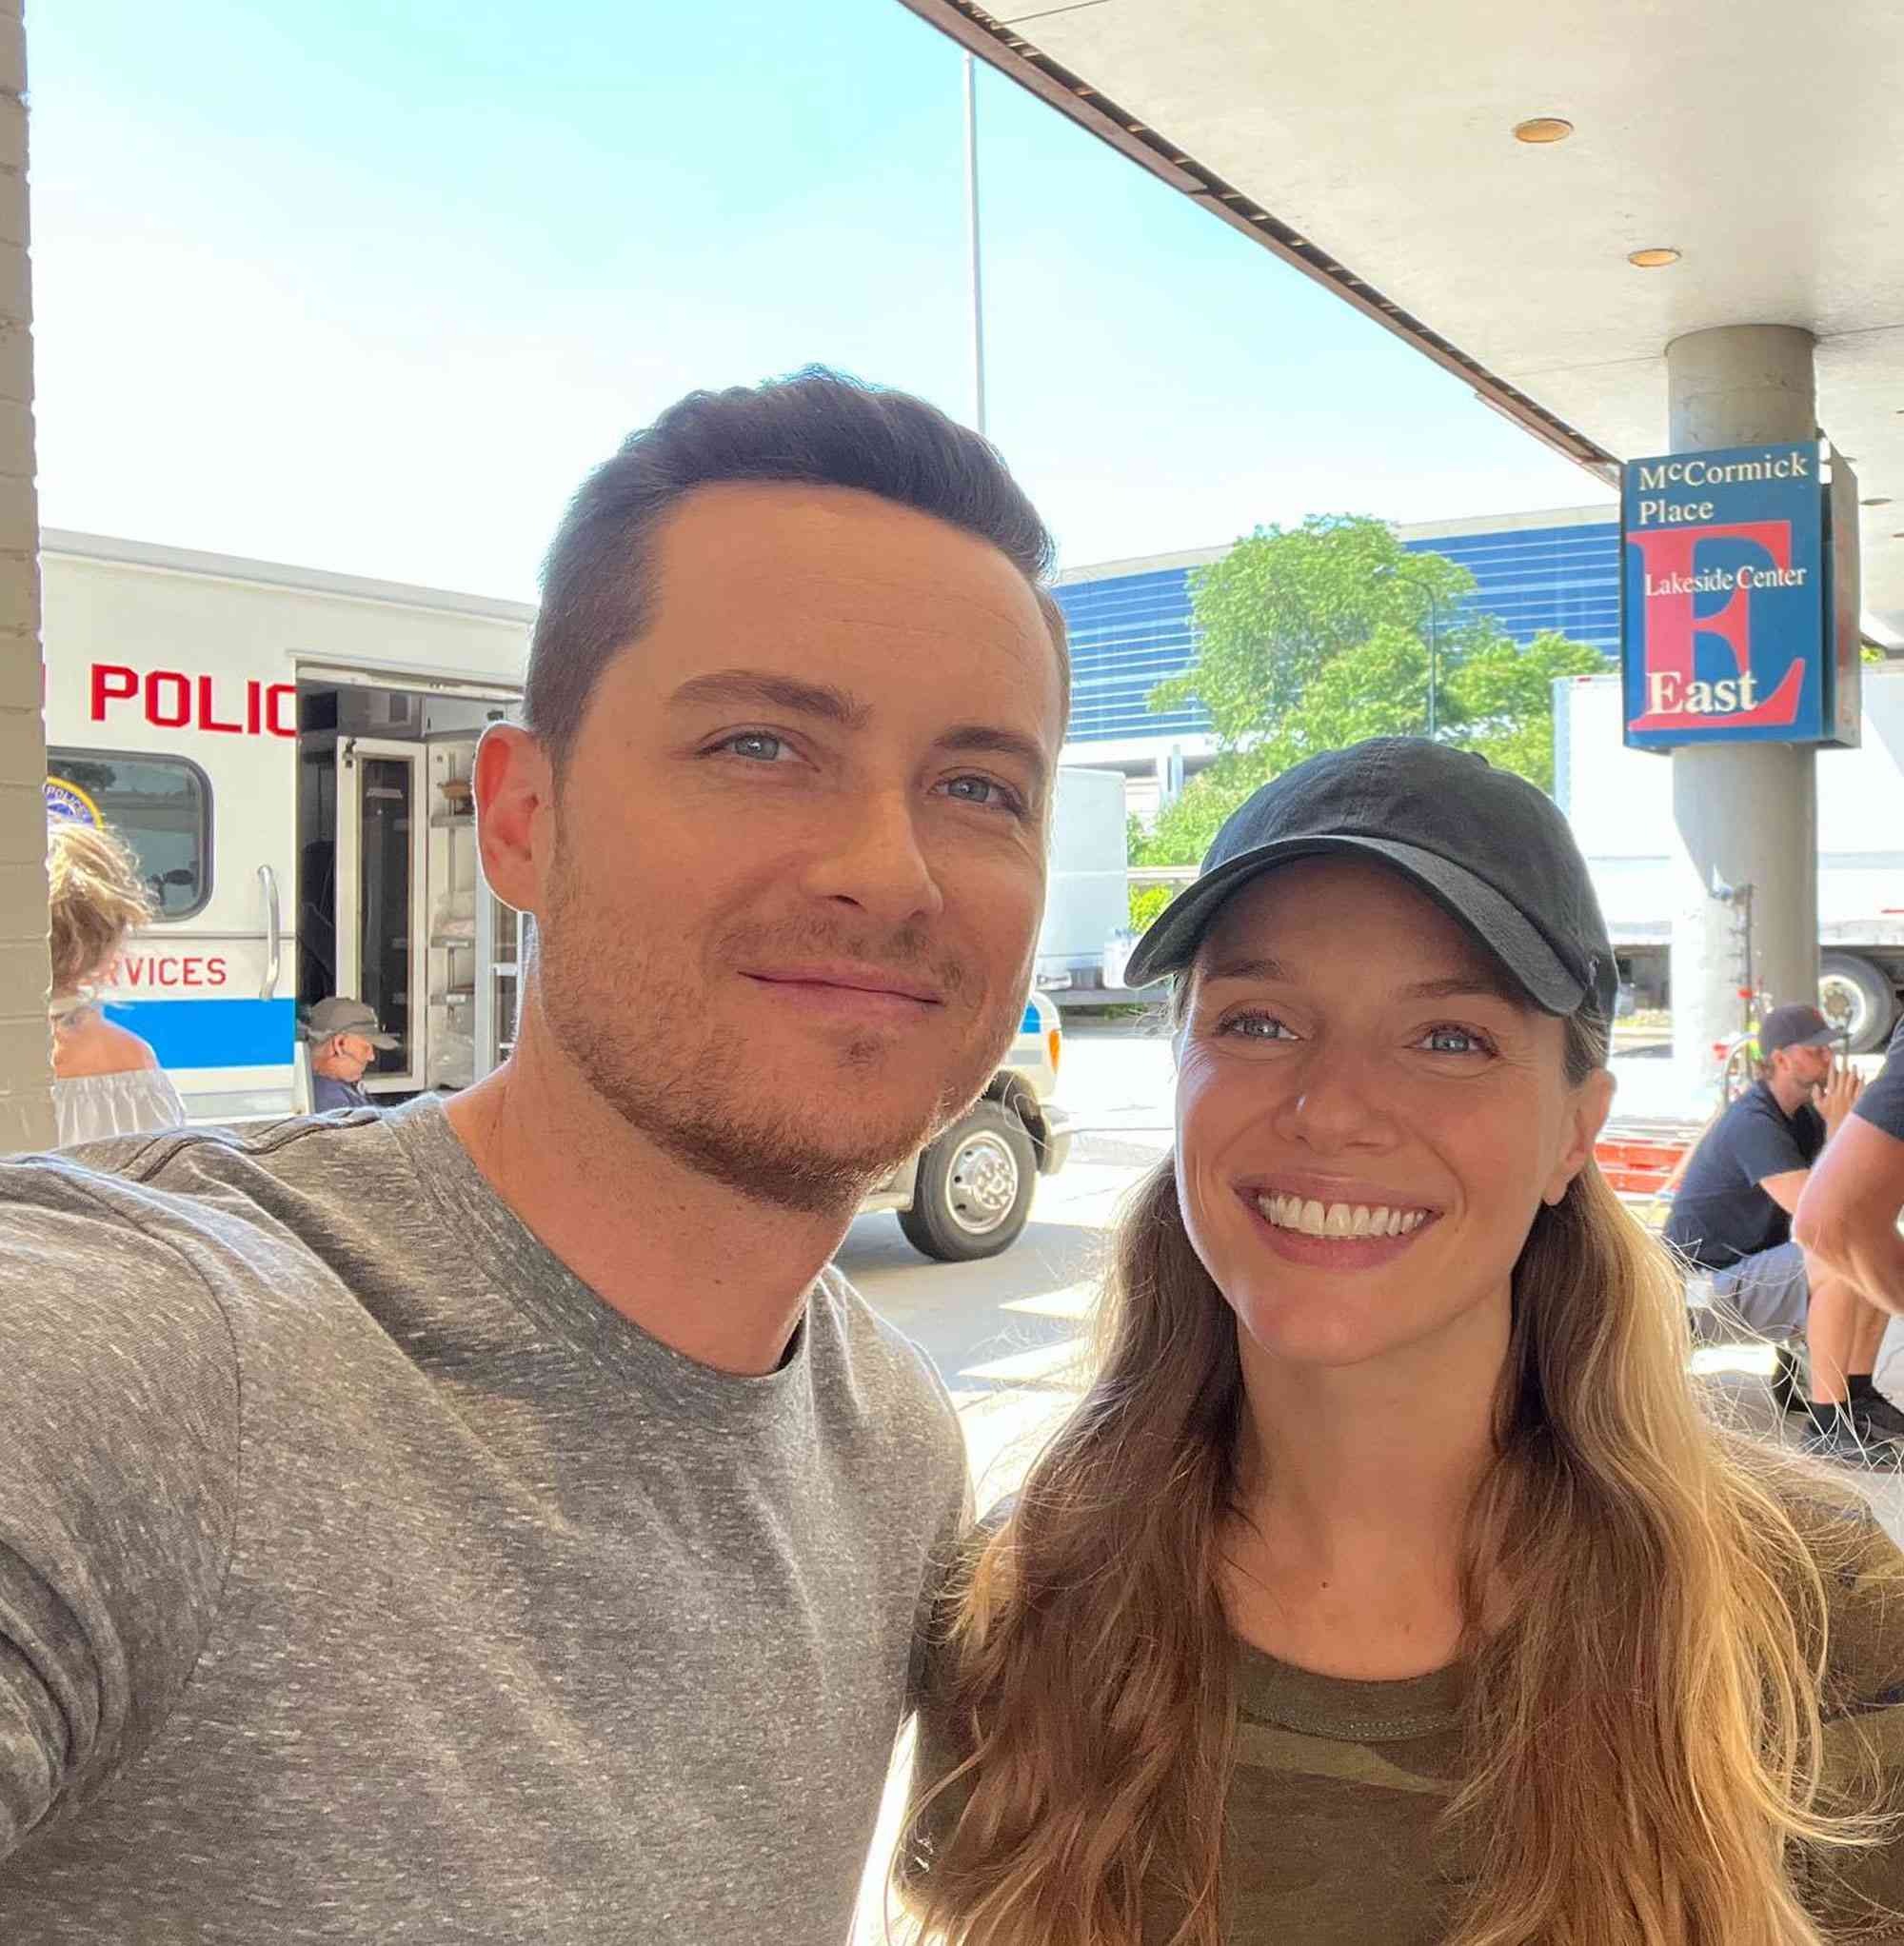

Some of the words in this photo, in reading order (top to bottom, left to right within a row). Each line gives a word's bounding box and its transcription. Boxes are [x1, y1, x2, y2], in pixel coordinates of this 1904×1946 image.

[1638, 451, 1808, 491] McCormick
[1638, 499, 1715, 525] Place
[1645, 569, 1734, 597] Lakeside
[1735, 566, 1808, 589] Center
[1626, 520, 1805, 731] E
[90, 663, 296, 739] POLIC
[1645, 669, 1760, 715] East
[107, 957, 227, 986] RVICES
